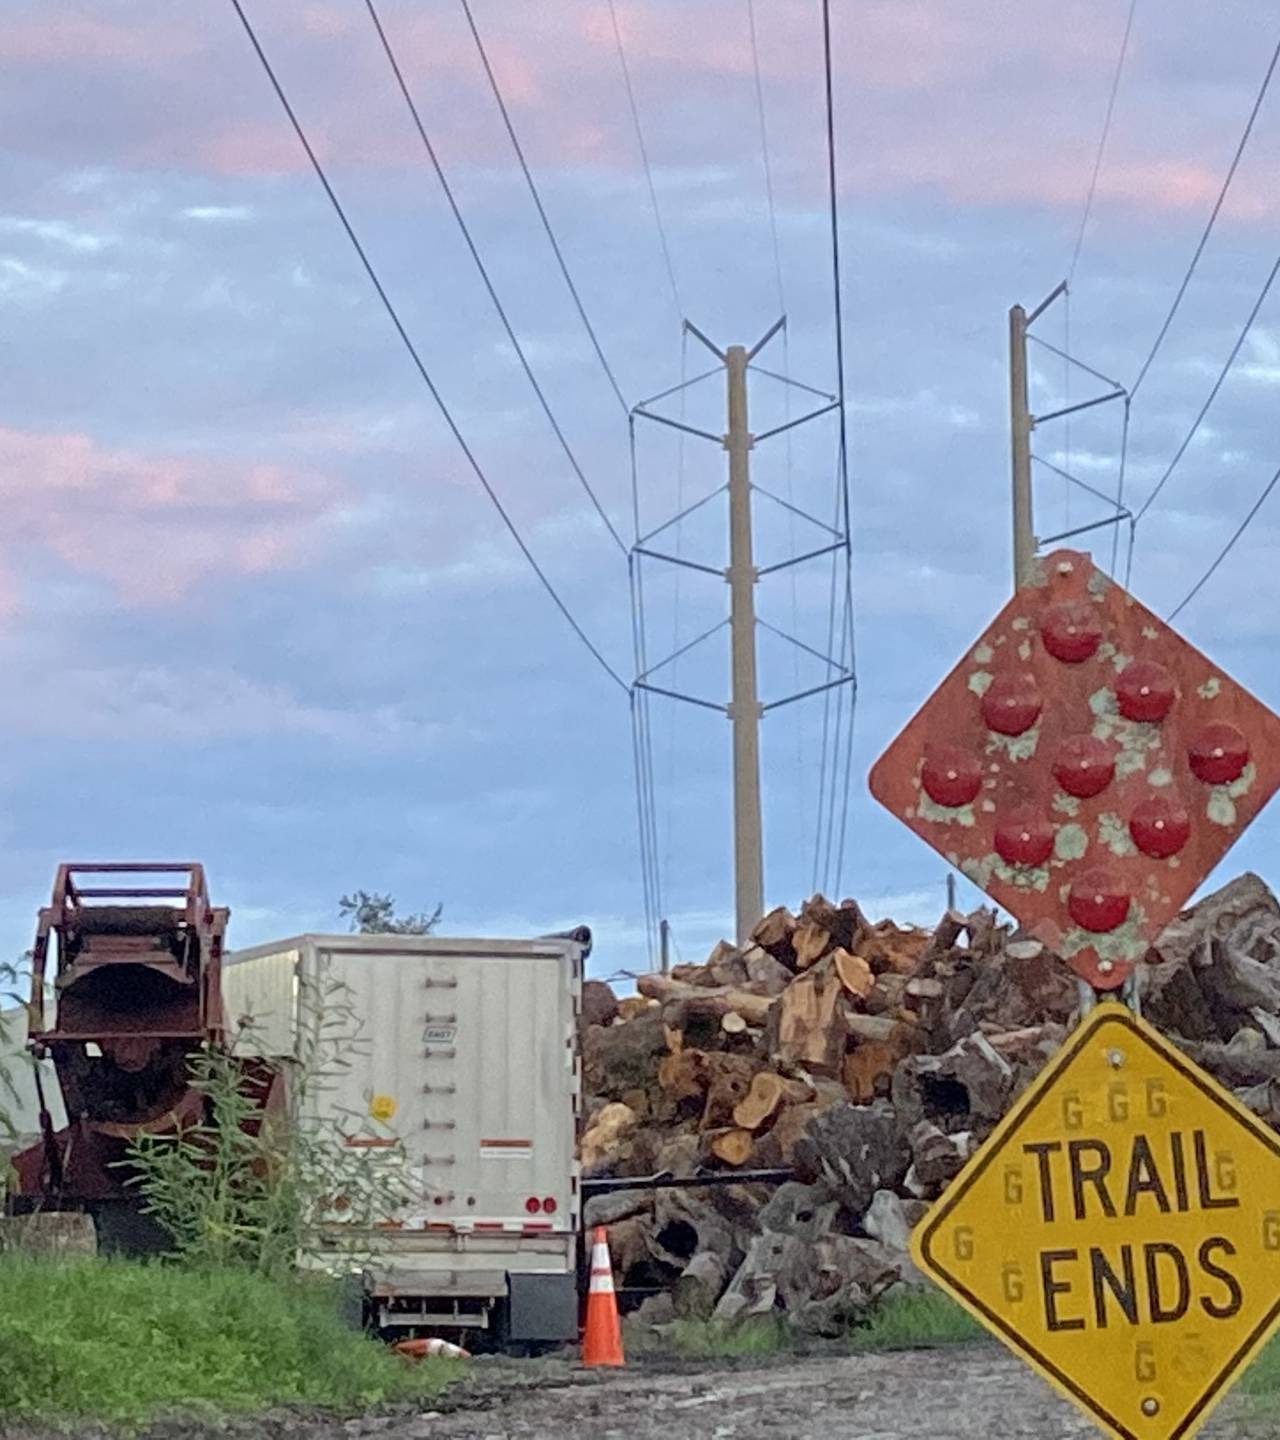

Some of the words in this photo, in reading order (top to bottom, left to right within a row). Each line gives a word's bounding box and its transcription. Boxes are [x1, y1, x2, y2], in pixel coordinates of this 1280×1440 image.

[1023, 1129, 1239, 1222] TRAIL
[954, 1226, 974, 1261] G
[1041, 1237, 1242, 1332] ENDS
